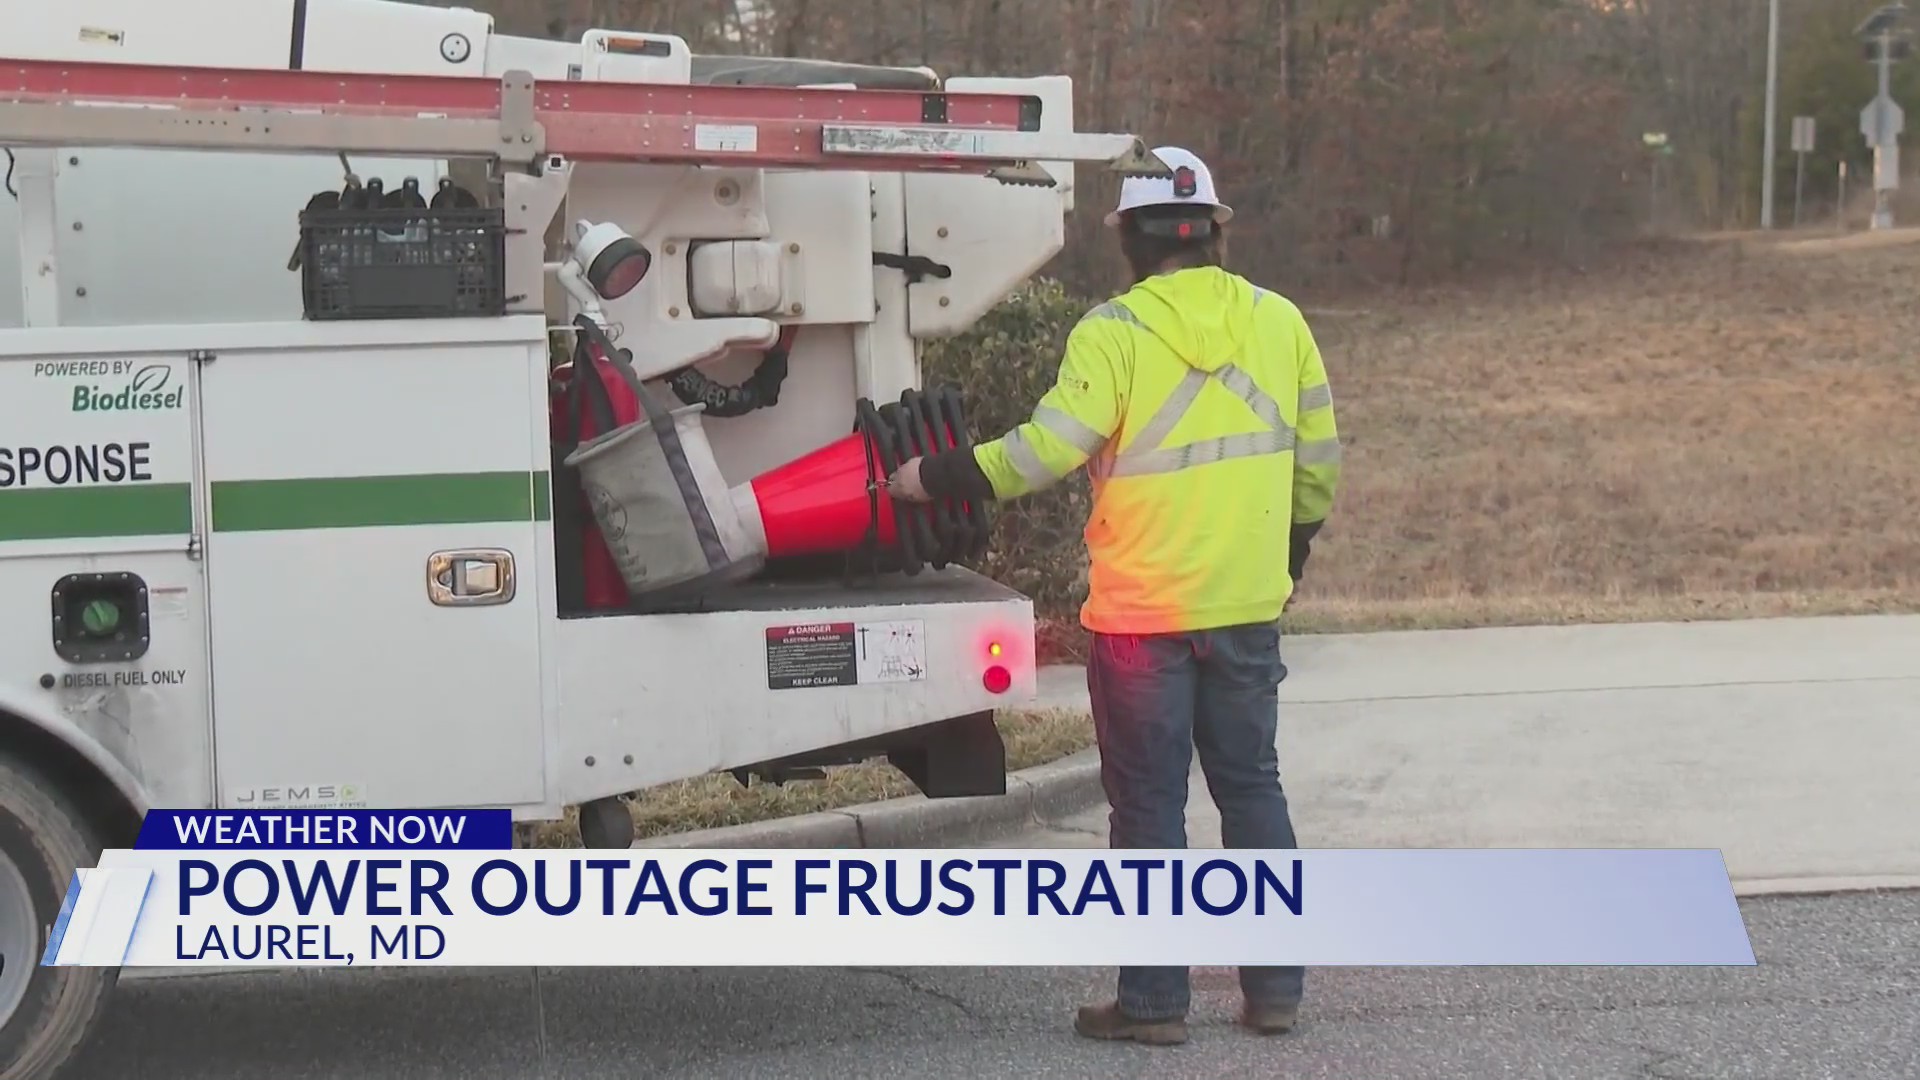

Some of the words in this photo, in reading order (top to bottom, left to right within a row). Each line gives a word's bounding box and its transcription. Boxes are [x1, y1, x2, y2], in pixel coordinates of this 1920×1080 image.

[34, 361, 109, 377] POWERED
[113, 361, 133, 375] BY
[72, 385, 183, 411] Biodiesel
[796, 625, 831, 635] DANGER
[63, 671, 111, 688] DIESEL
[114, 671, 148, 687] FUEL
[151, 670, 186, 686] ONLY
[792, 678, 812, 687] KEEP
[813, 677, 838, 685] CLEAR
